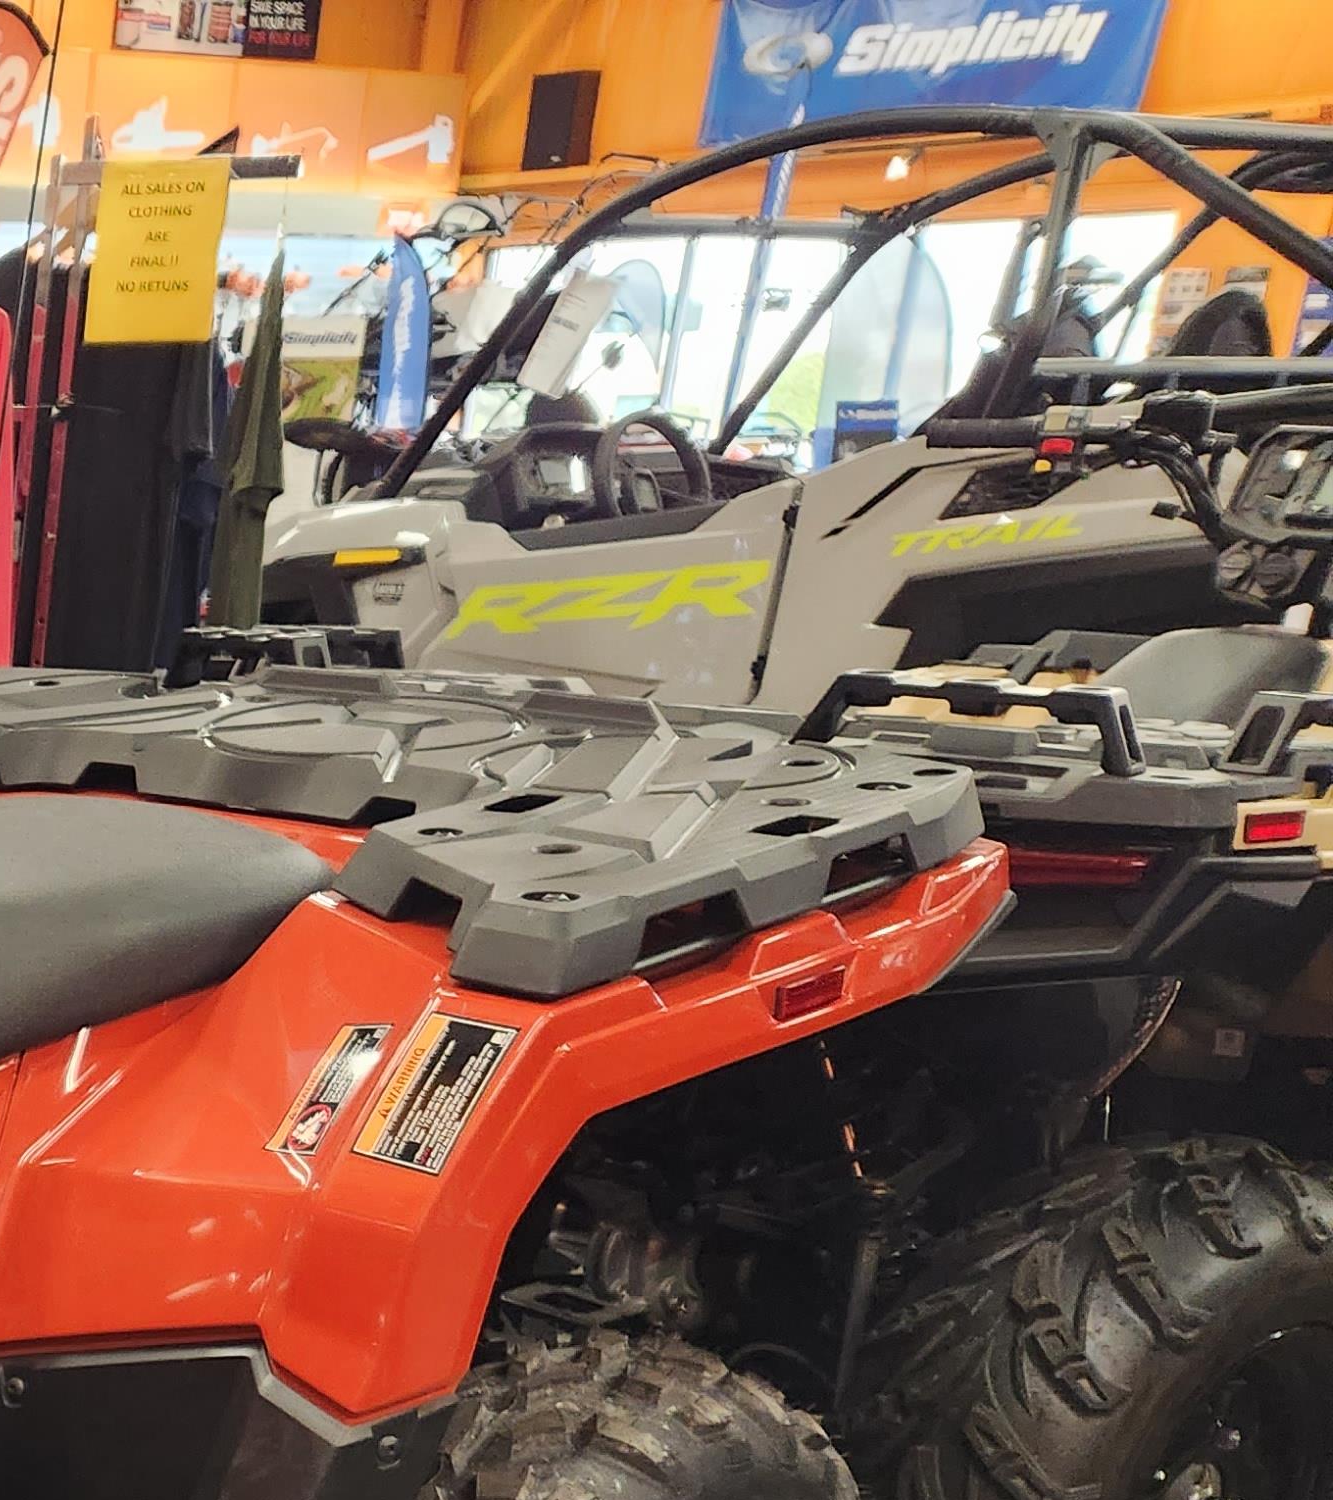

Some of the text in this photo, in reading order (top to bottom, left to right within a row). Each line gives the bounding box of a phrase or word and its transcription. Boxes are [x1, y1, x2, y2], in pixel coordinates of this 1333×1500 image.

[834, 4, 1109, 77] Simplicity
[121, 181, 206, 195] ALL SALES ON
[128, 205, 192, 218] CLOTHING
[145, 231, 170, 242] ARE
[129, 256, 165, 268] FINAL
[116, 280, 189, 293] NO RETUNS
[891, 512, 1083, 559] TRAIL
[443, 559, 771, 641] RZR
[385, 1046, 427, 1106] WARNING
